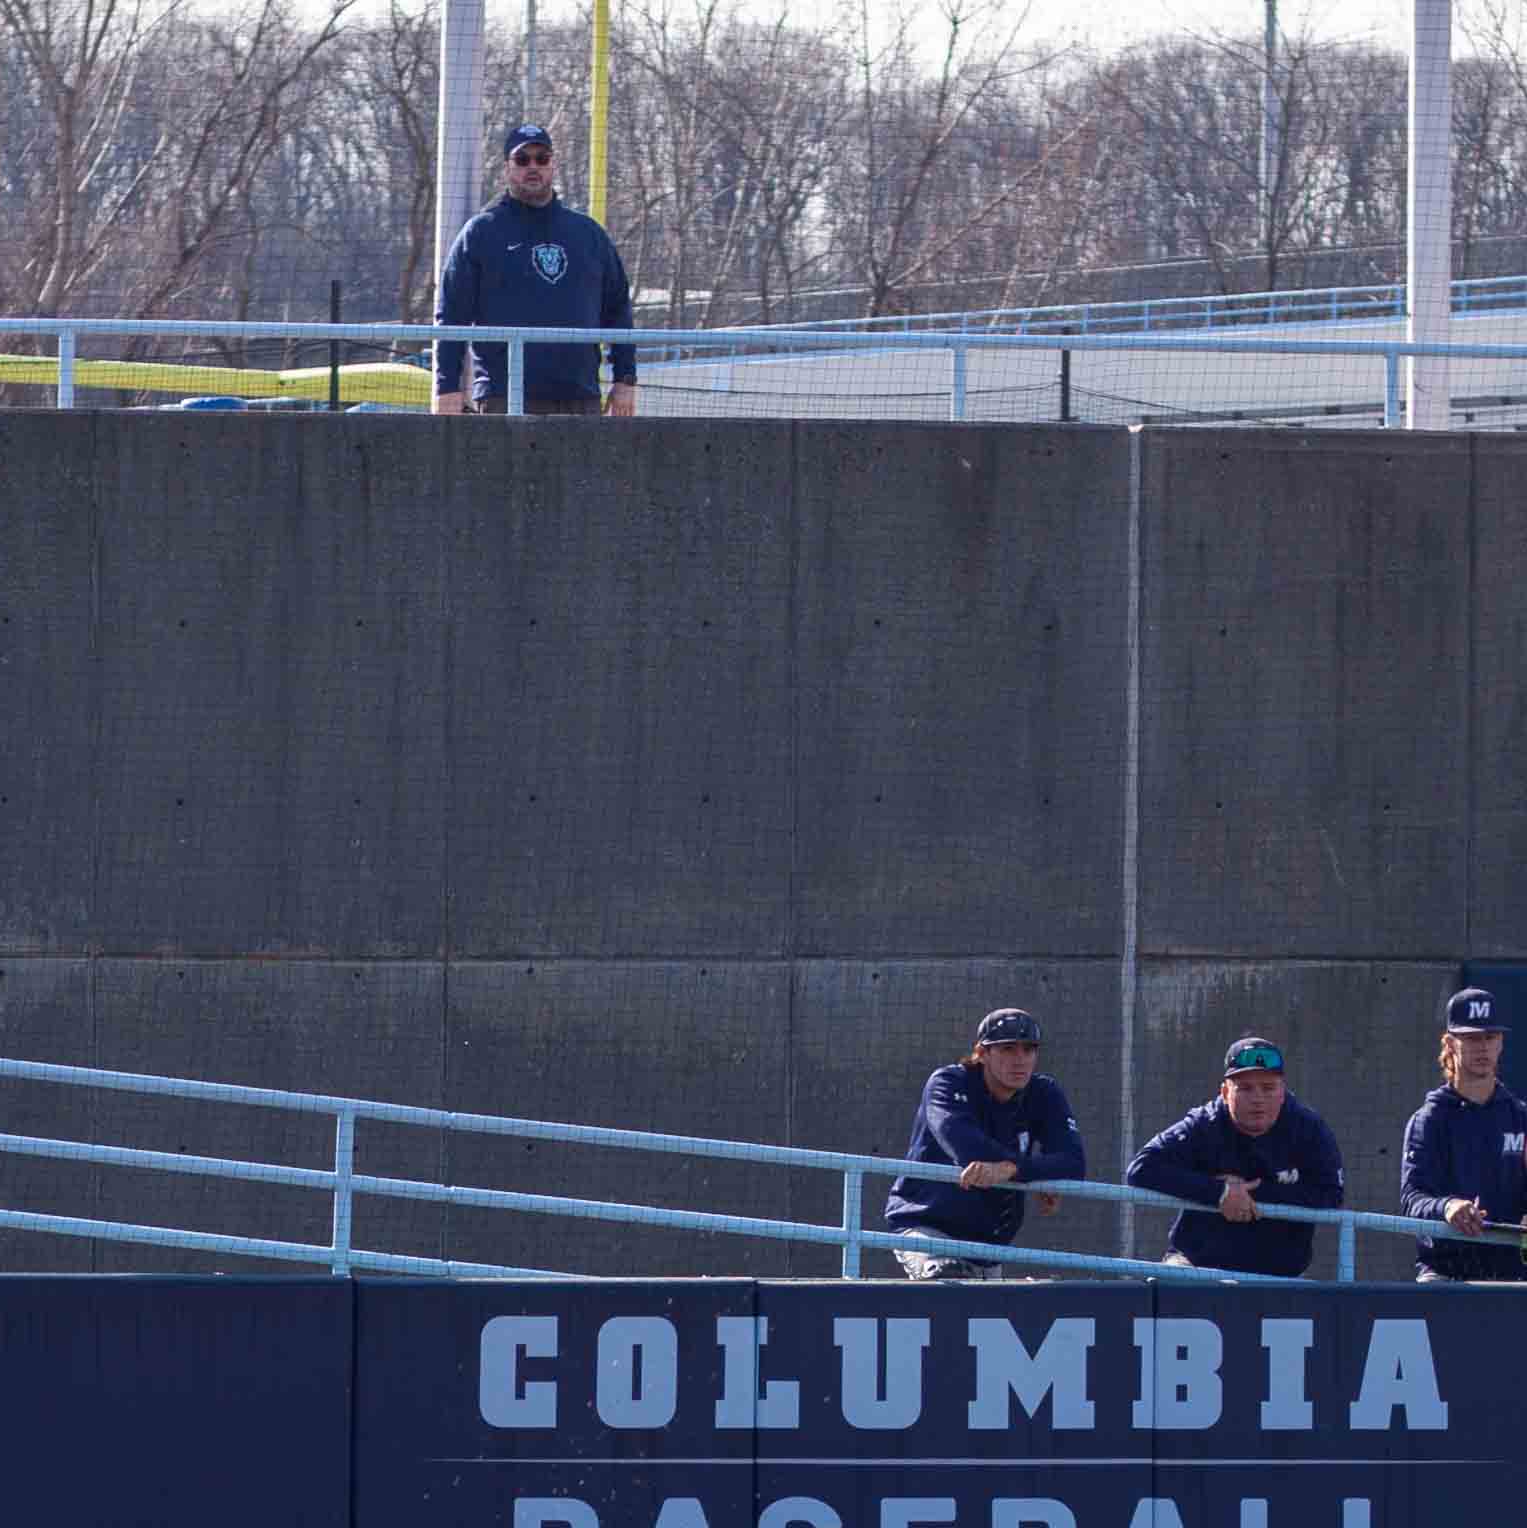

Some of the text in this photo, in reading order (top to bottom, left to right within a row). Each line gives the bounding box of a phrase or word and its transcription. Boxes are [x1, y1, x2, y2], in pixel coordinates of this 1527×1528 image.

[1469, 1001, 1491, 1019] M
[1503, 1132, 1525, 1152] M
[478, 1315, 1449, 1431] COLUMBIA
